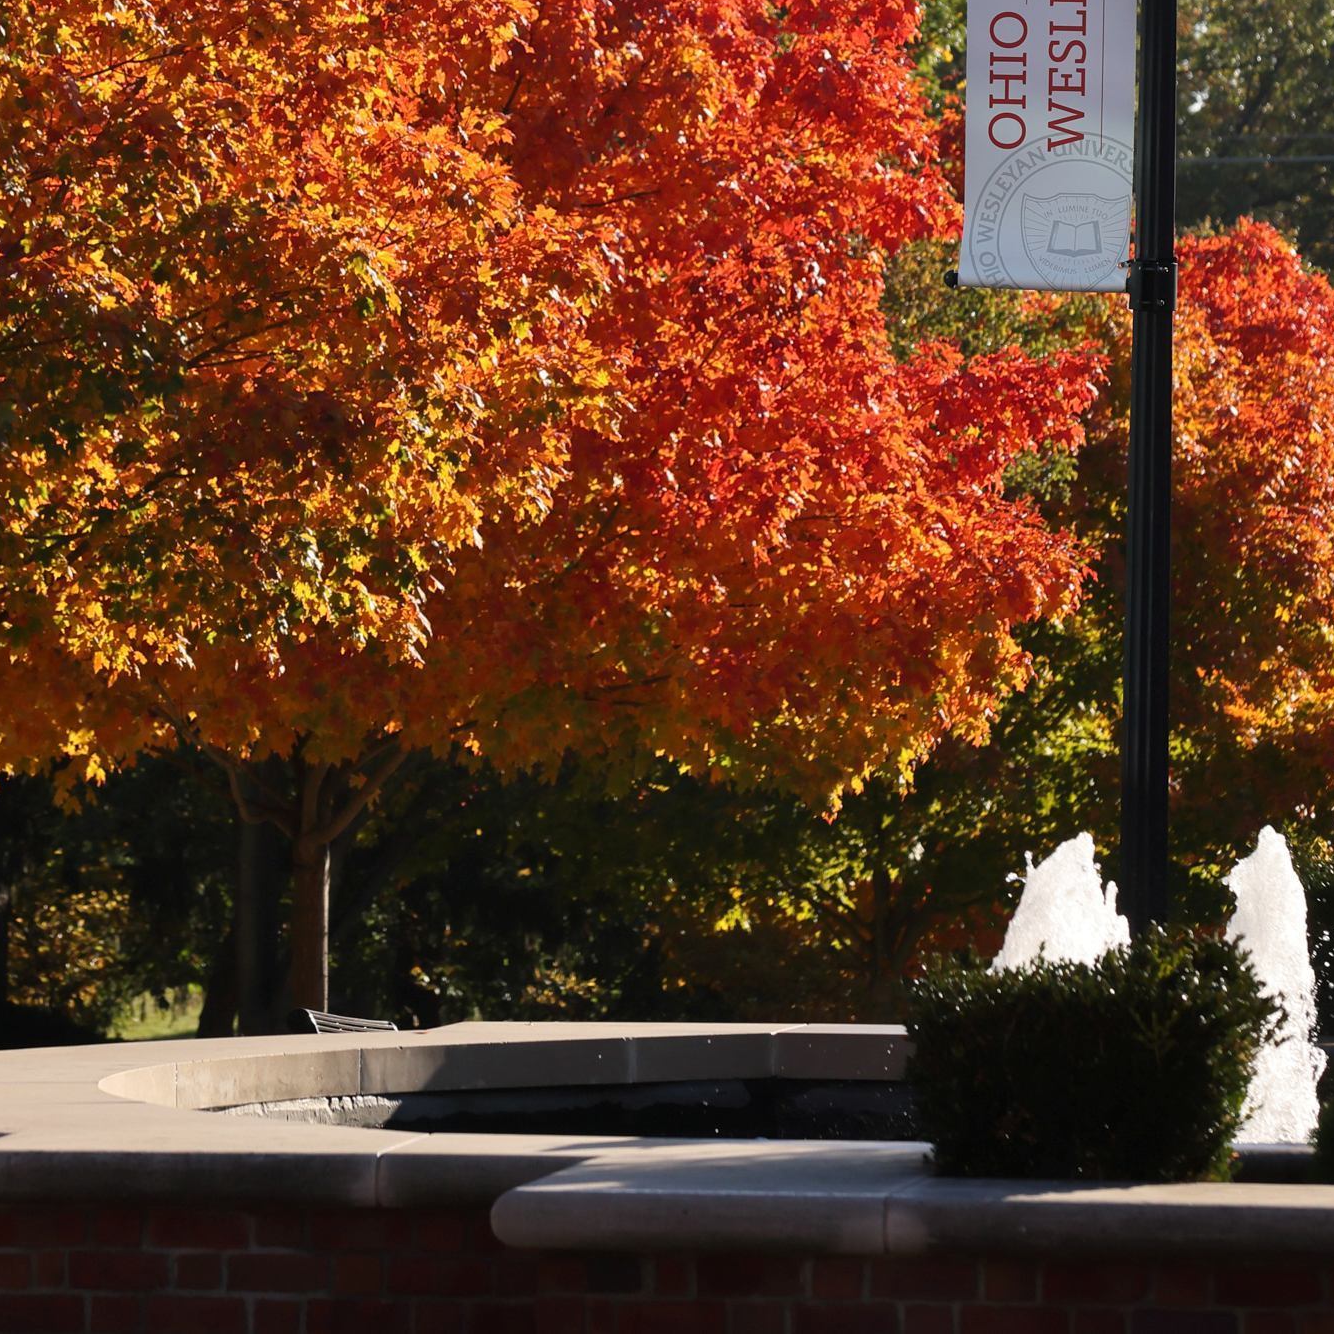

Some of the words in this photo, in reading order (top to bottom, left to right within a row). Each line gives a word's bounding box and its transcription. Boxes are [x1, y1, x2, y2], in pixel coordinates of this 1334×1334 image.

[988, 11, 1028, 150] OHIO
[976, 146, 1047, 244] WESLEYAN
[1057, 205, 1089, 214] LUMINE
[979, 251, 1010, 288] HIO
